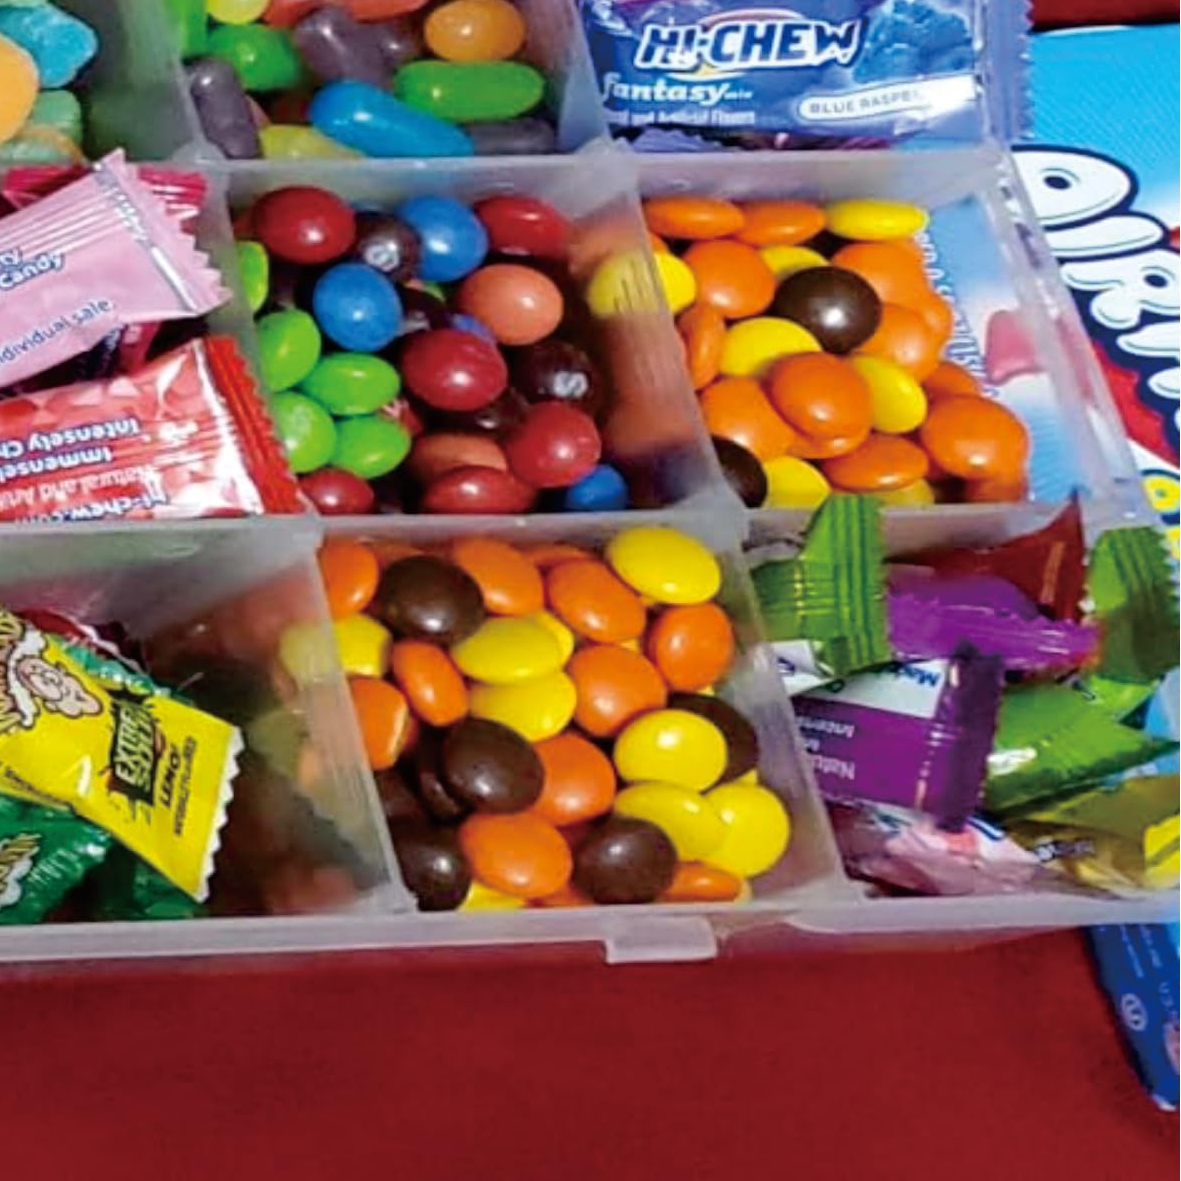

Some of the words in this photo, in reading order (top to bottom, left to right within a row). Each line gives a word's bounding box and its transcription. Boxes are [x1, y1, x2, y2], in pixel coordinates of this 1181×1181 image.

[635, 17, 863, 69] HI-CHEW
[601, 71, 727, 106] fantasy
[808, 97, 856, 116] BLUE
[26, 416, 142, 453] Intensely
